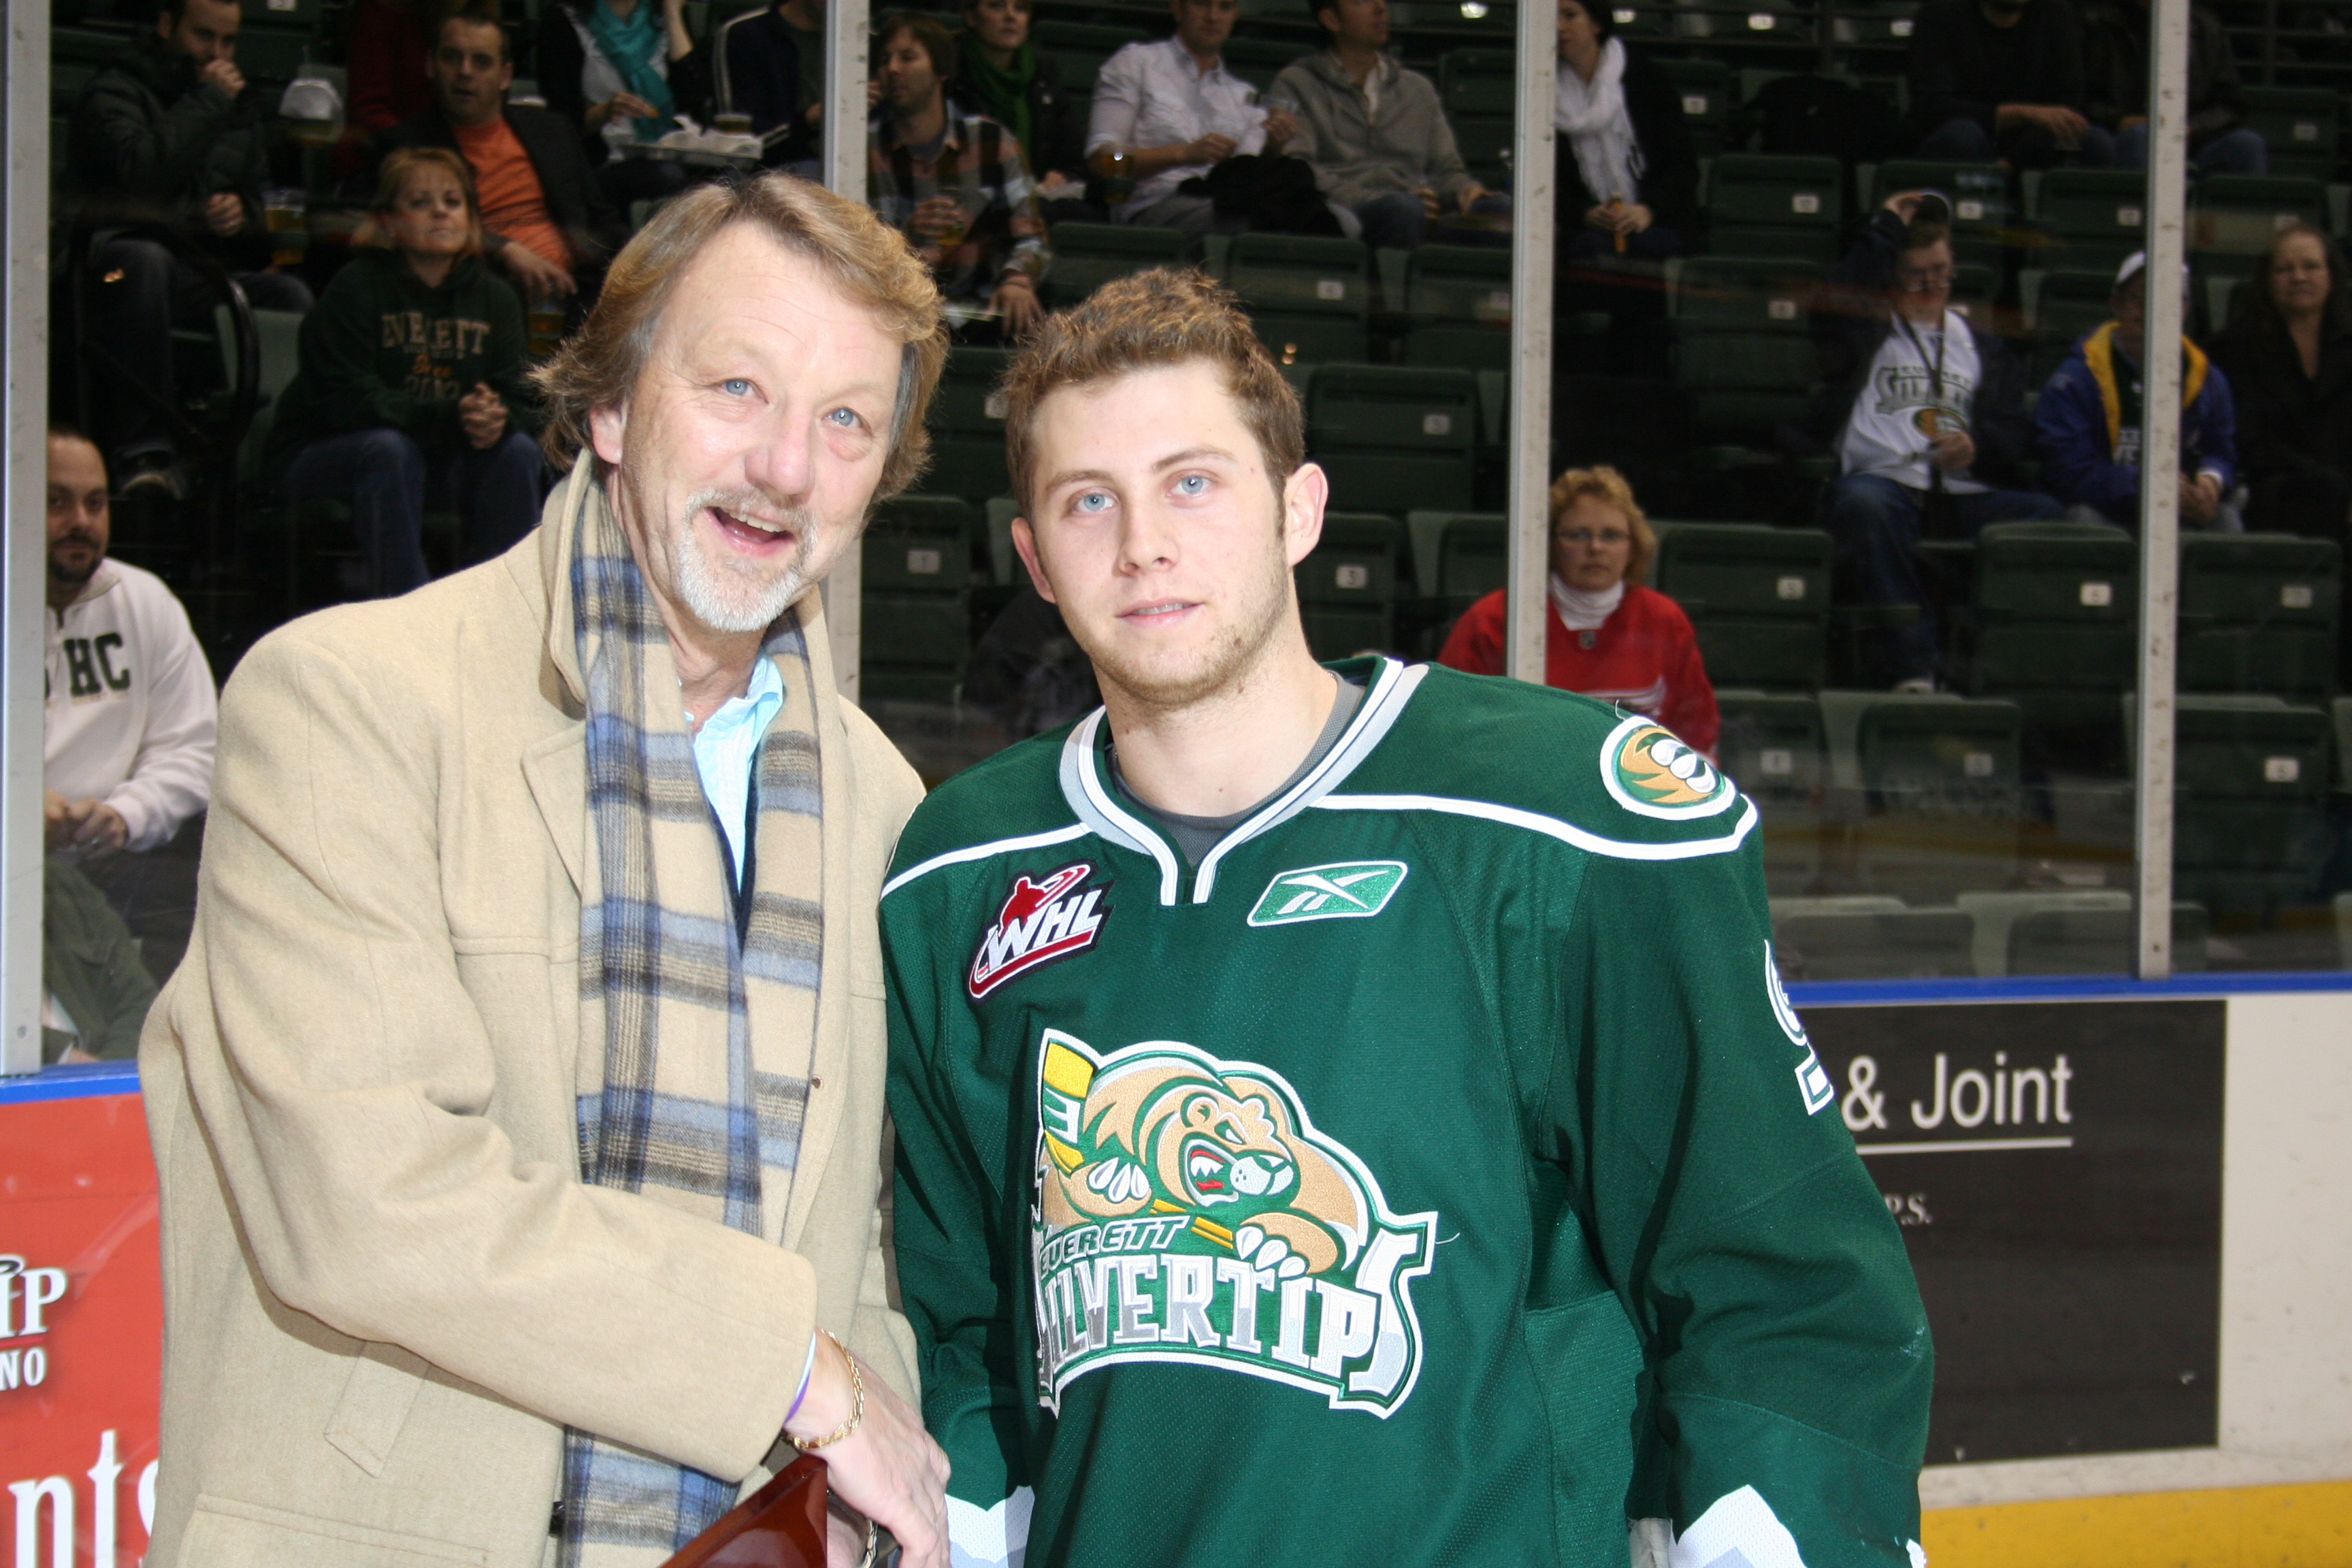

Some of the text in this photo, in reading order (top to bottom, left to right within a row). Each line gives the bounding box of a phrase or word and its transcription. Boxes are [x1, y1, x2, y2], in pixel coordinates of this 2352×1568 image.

[381, 311, 492, 355] EVEETT
[44, 632, 131, 700] HC
[987, 889, 1103, 972] WHL
[1841, 1051, 2074, 1131] & Joint
